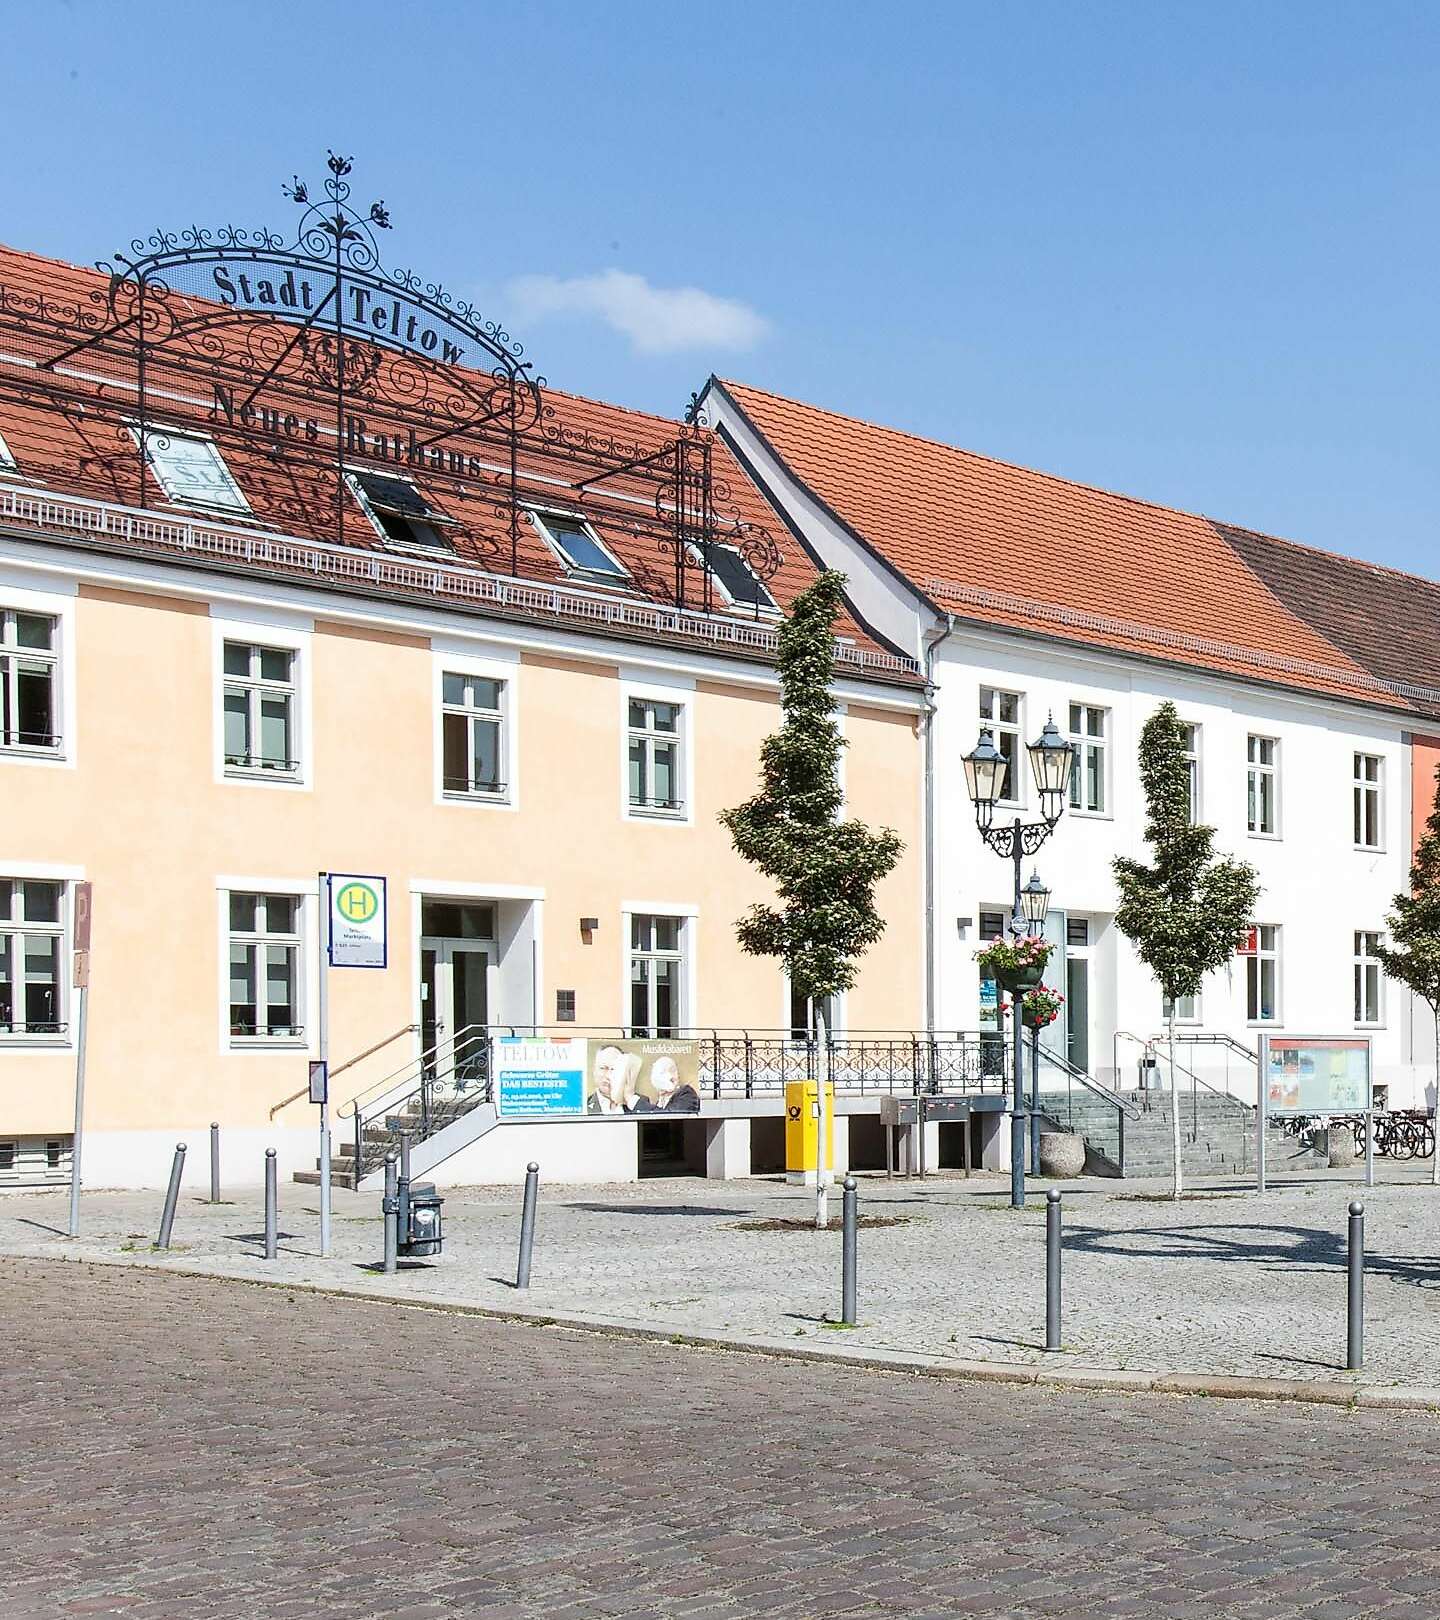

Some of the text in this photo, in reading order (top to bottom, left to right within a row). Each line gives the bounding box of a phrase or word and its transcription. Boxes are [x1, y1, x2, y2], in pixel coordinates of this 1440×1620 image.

[213, 266, 466, 366] Stadt Teltow
[209, 384, 480, 477] Neues Rathaus
[349, 891, 366, 915] H
[501, 1046, 569, 1061] TELTOW
